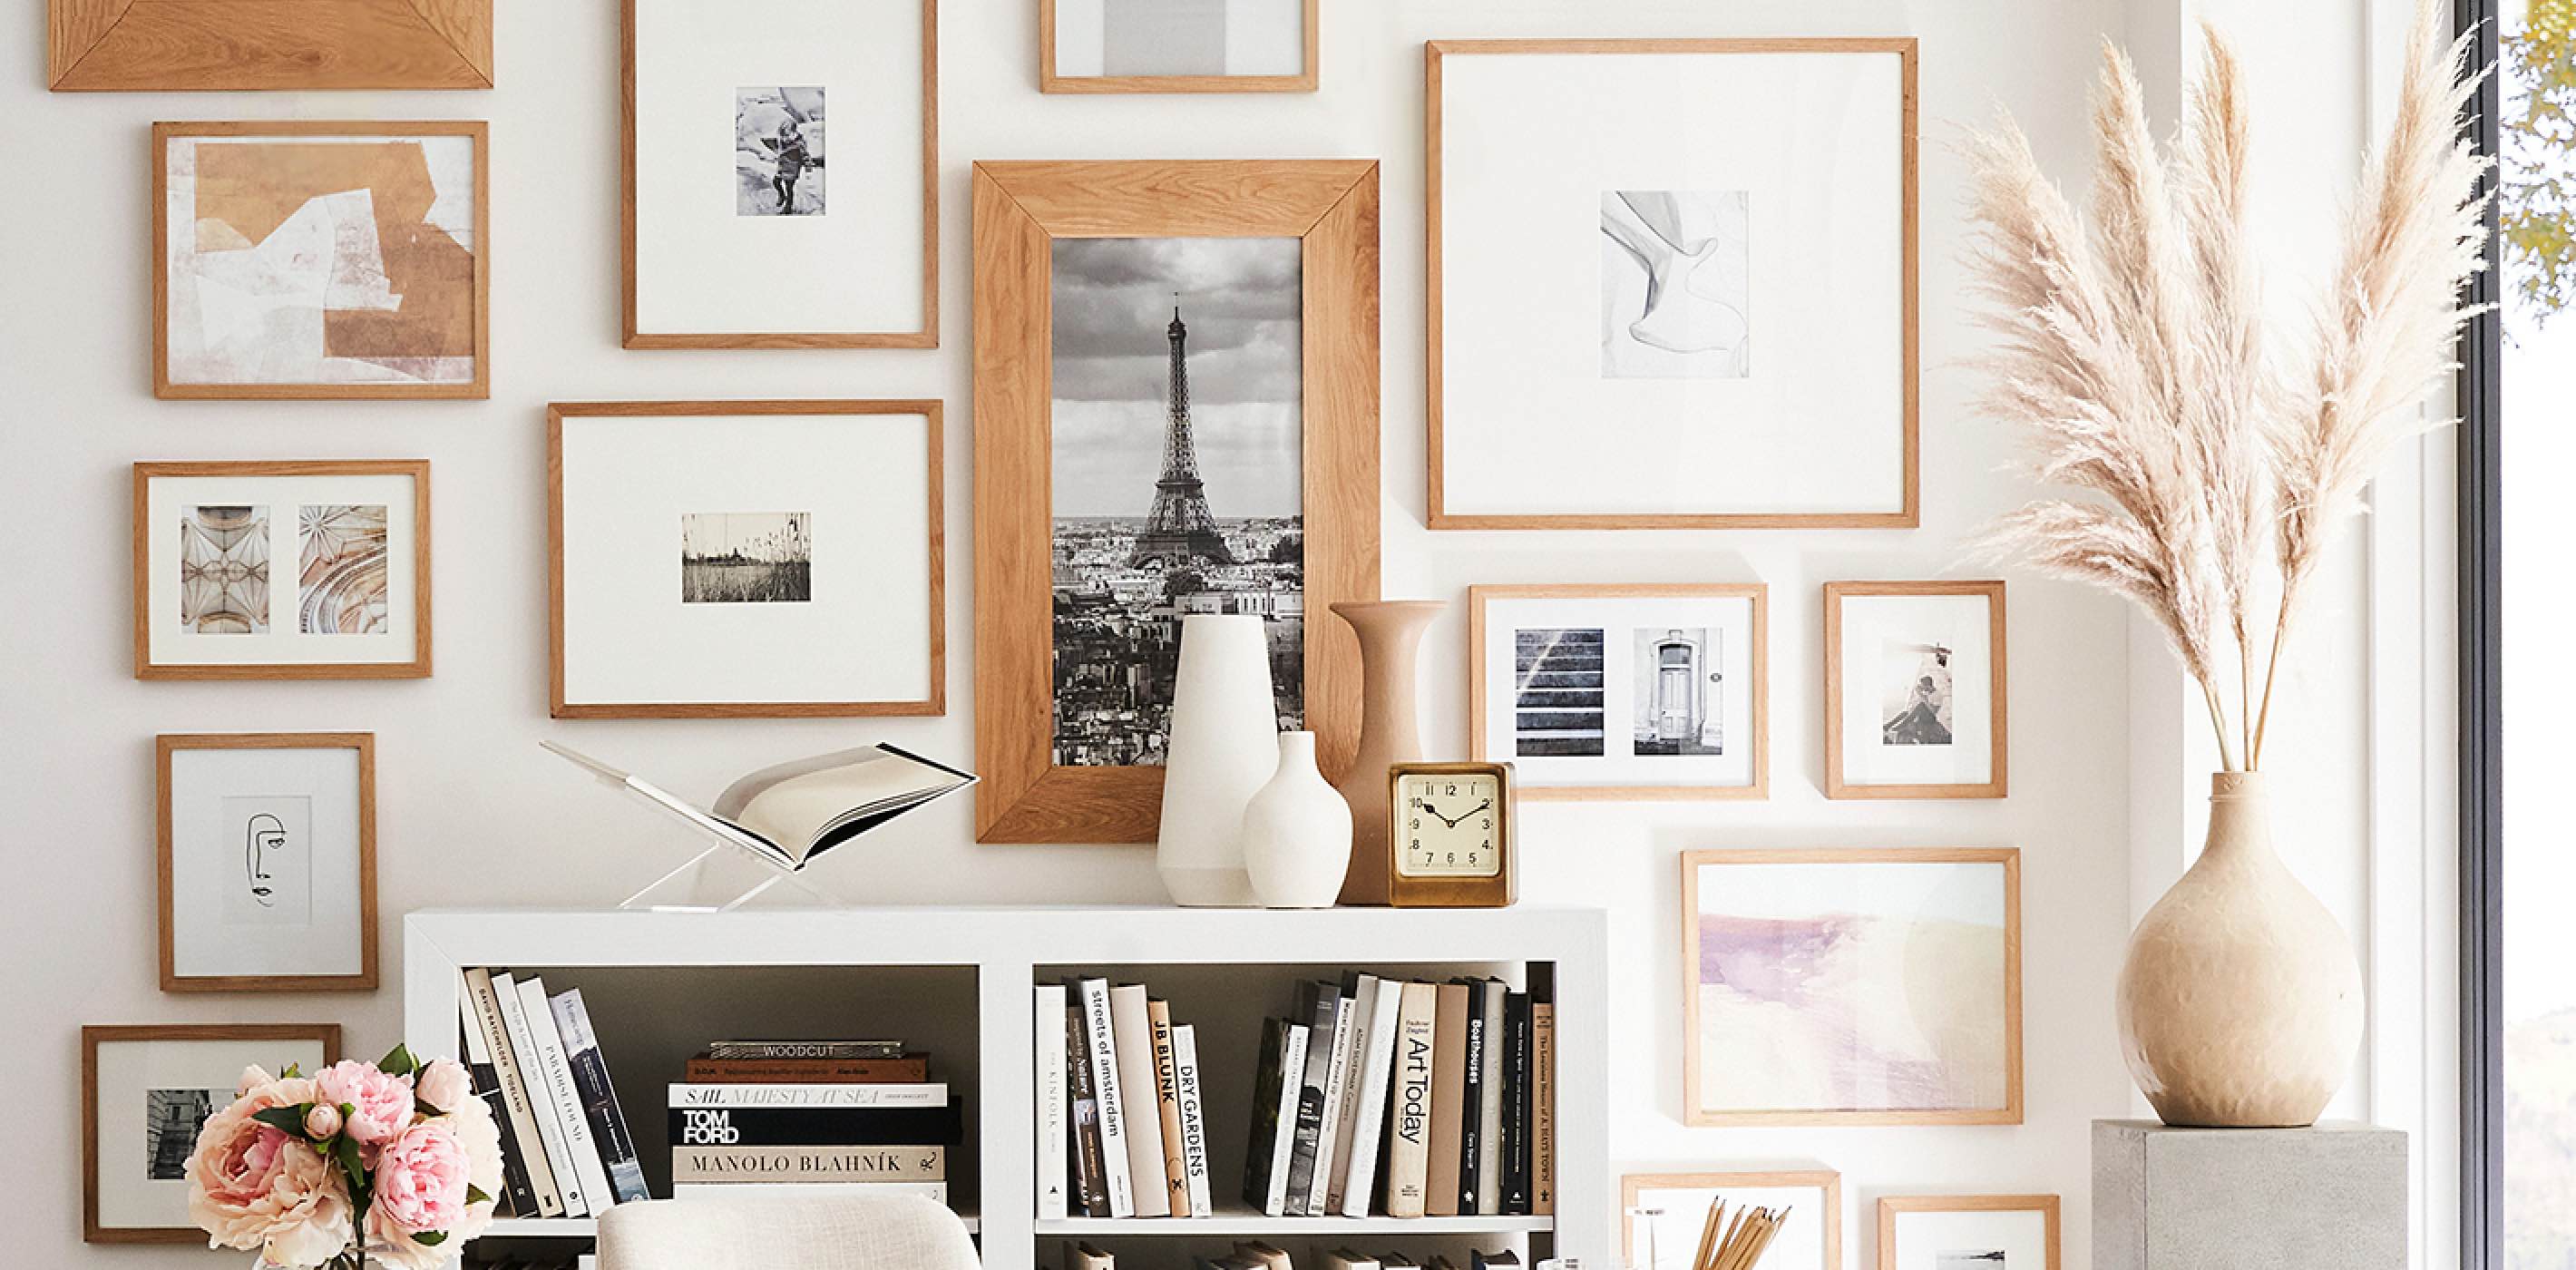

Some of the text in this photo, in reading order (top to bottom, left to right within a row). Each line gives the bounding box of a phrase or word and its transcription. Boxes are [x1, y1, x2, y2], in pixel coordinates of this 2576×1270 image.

[1426, 784, 1434, 796] 11
[1445, 785, 1457, 796] 12
[1470, 784, 1475, 796] 1
[1410, 797, 1422, 808] 10
[1482, 798, 1489, 809] 2
[1412, 818, 1420, 829] 9
[1482, 818, 1489, 829] 3
[1412, 838, 1420, 850] 8
[1481, 839, 1489, 850] 4
[1426, 853, 1434, 863] 7
[1447, 853, 1455, 864] 6
[1469, 853, 1478, 864] 5
[763, 1045, 835, 1057] WOODCUT
[1408, 1038, 1429, 1073] Art
[1469, 1019, 1482, 1084] Boathouses
[1091, 990, 1119, 1137] streets of amsterdam
[1153, 1021, 1175, 1102] JB BLUNK
[1180, 1066, 1195, 1095] DRY
[733, 1089, 811, 1104] MAJESTY
[1399, 1076, 1429, 1145] Today
[682, 1109, 730, 1128] TOM
[683, 1127, 740, 1144] FORD
[1184, 1099, 1204, 1177] GARDENS
[692, 1154, 790, 1172] MANOLO
